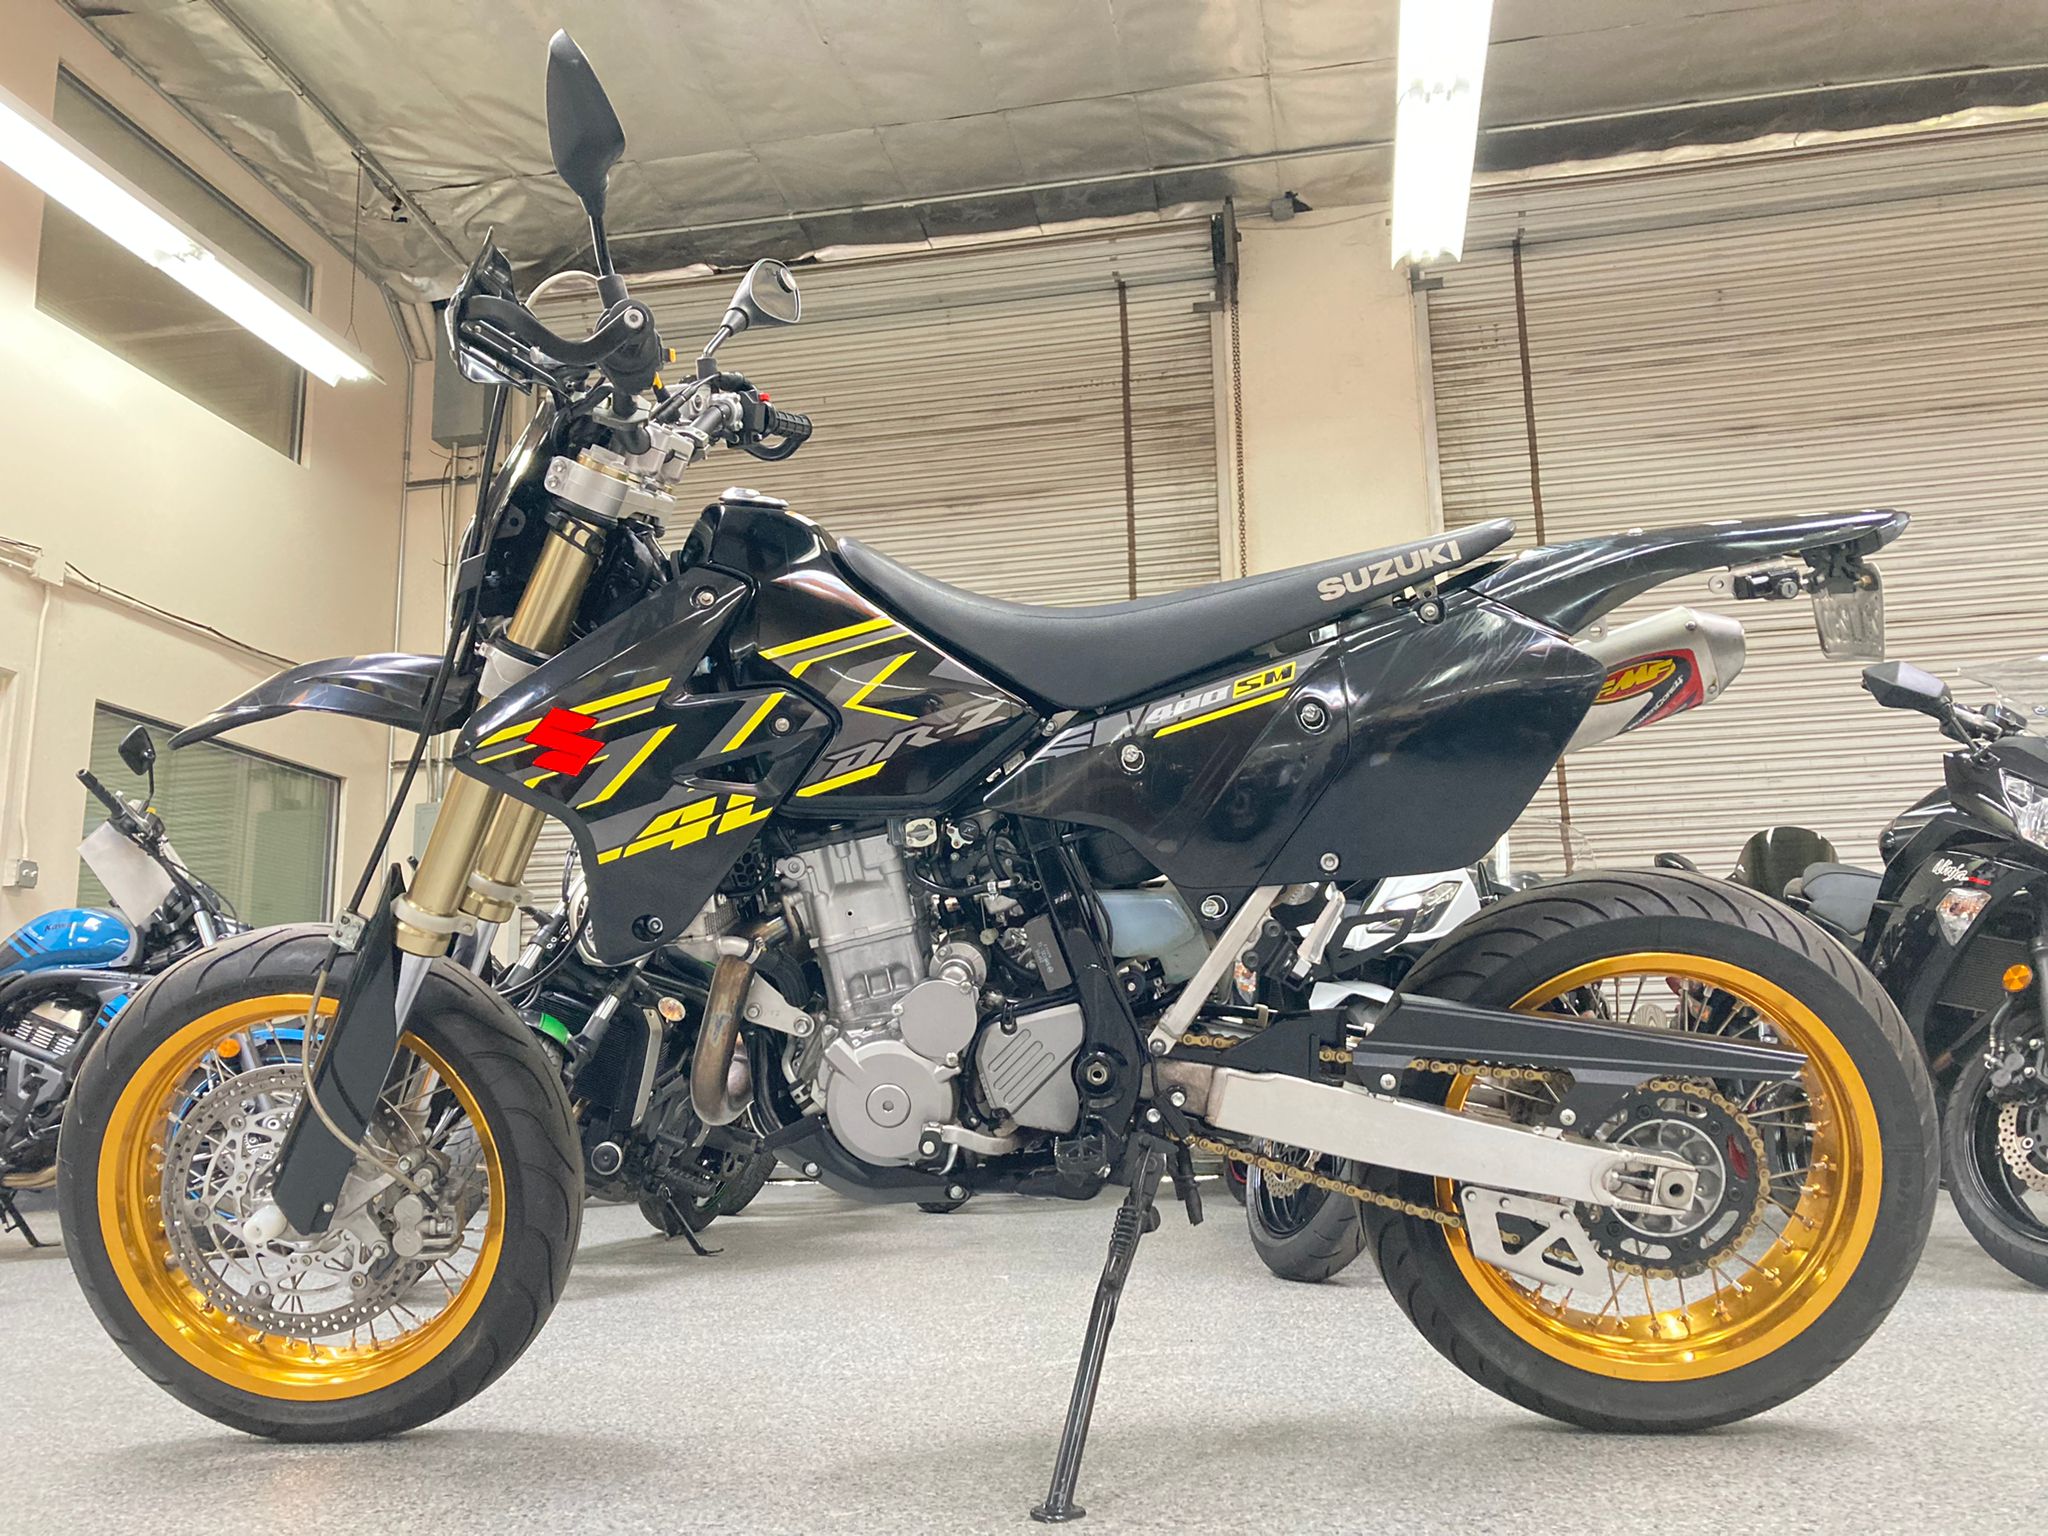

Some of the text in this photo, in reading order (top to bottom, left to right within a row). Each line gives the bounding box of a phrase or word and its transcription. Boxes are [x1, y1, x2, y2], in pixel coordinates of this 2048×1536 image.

[1316, 539, 1462, 601] SUZUKI
[1143, 664, 1293, 725] 400 SM
[1598, 658, 1674, 697] FMF
[823, 699, 1007, 780] DR-Z
[1931, 858, 1969, 882] Ninja
